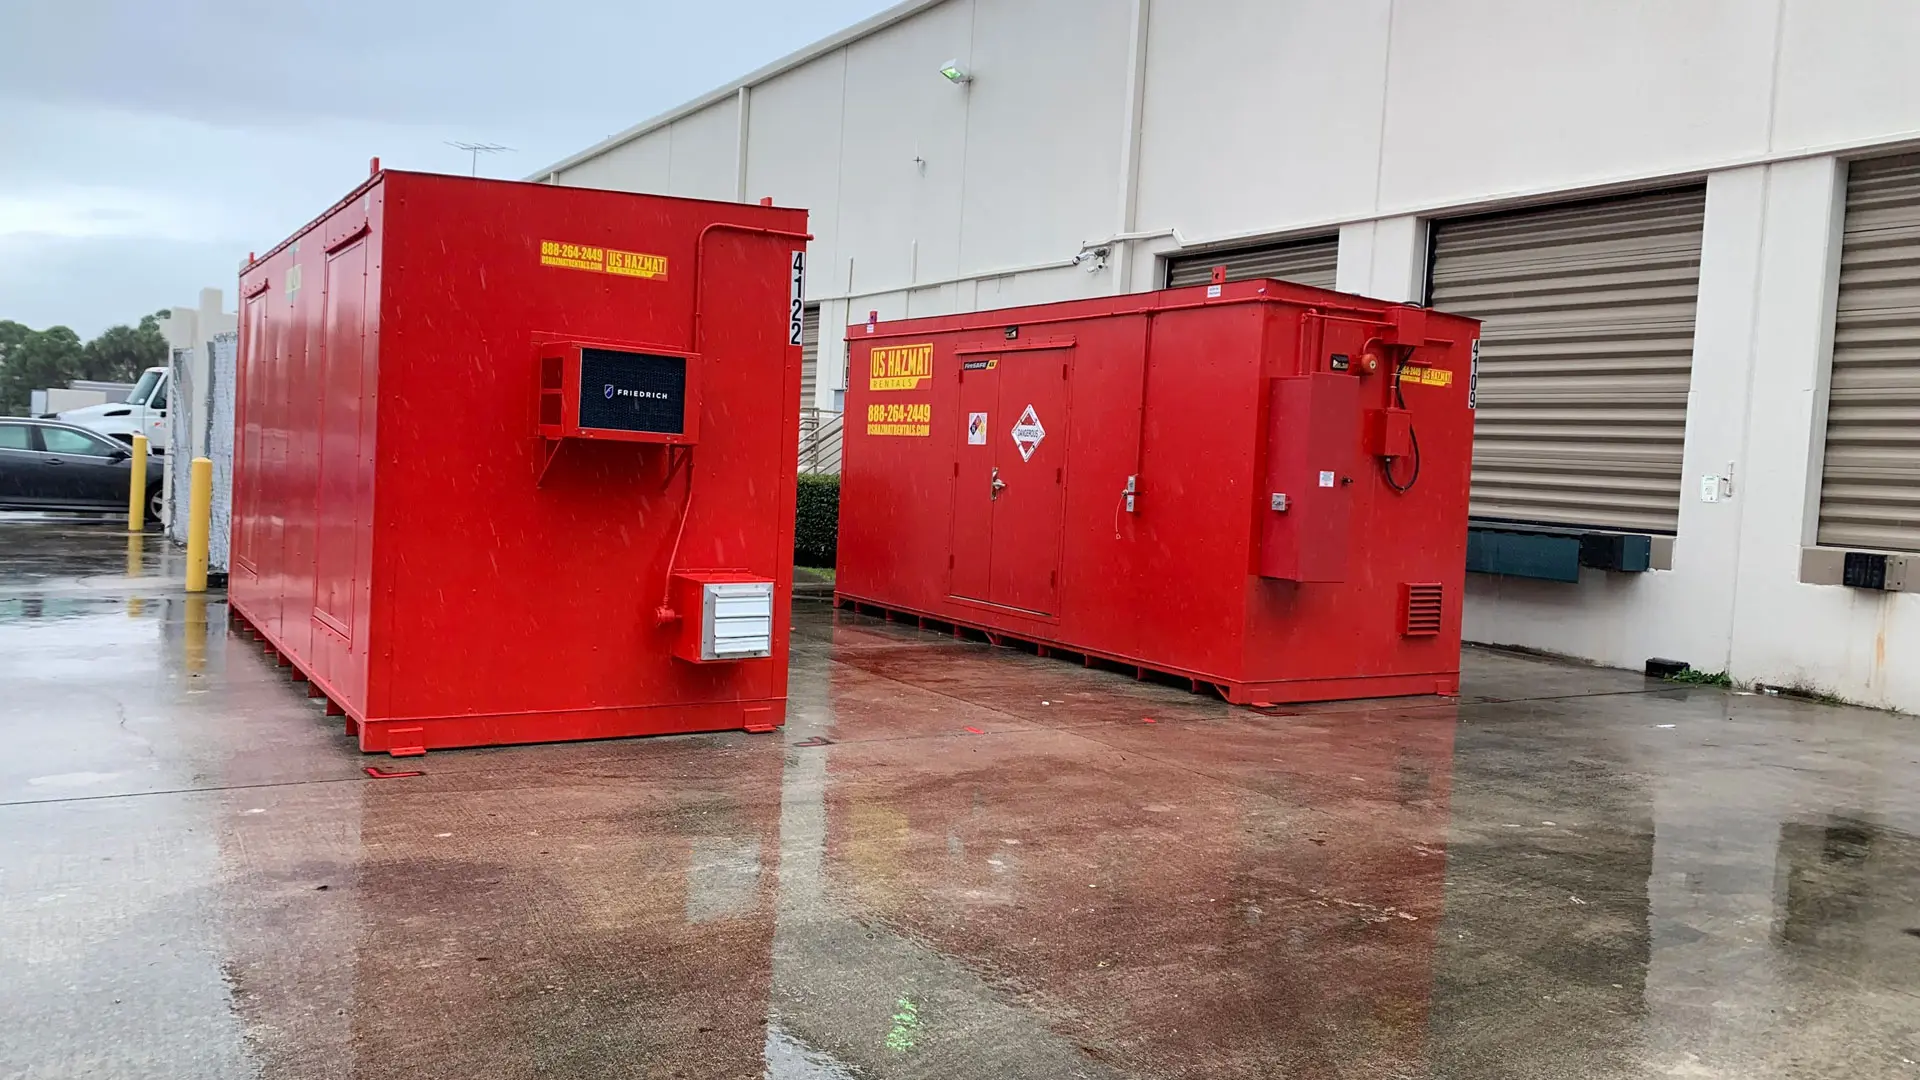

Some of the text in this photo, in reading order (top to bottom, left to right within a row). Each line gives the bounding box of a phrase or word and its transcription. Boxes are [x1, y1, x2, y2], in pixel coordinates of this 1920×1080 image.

[542, 242, 603, 262] 888-264-2449
[609, 252, 665, 272] US HAZMAT
[790, 252, 803, 345] 4122
[872, 347, 931, 377] US HAZMAT
[873, 379, 912, 388] RENTALS
[1469, 340, 1478, 408] 4109
[617, 389, 668, 399] FRIEDRICH
[868, 404, 931, 422] 888-264-2449
